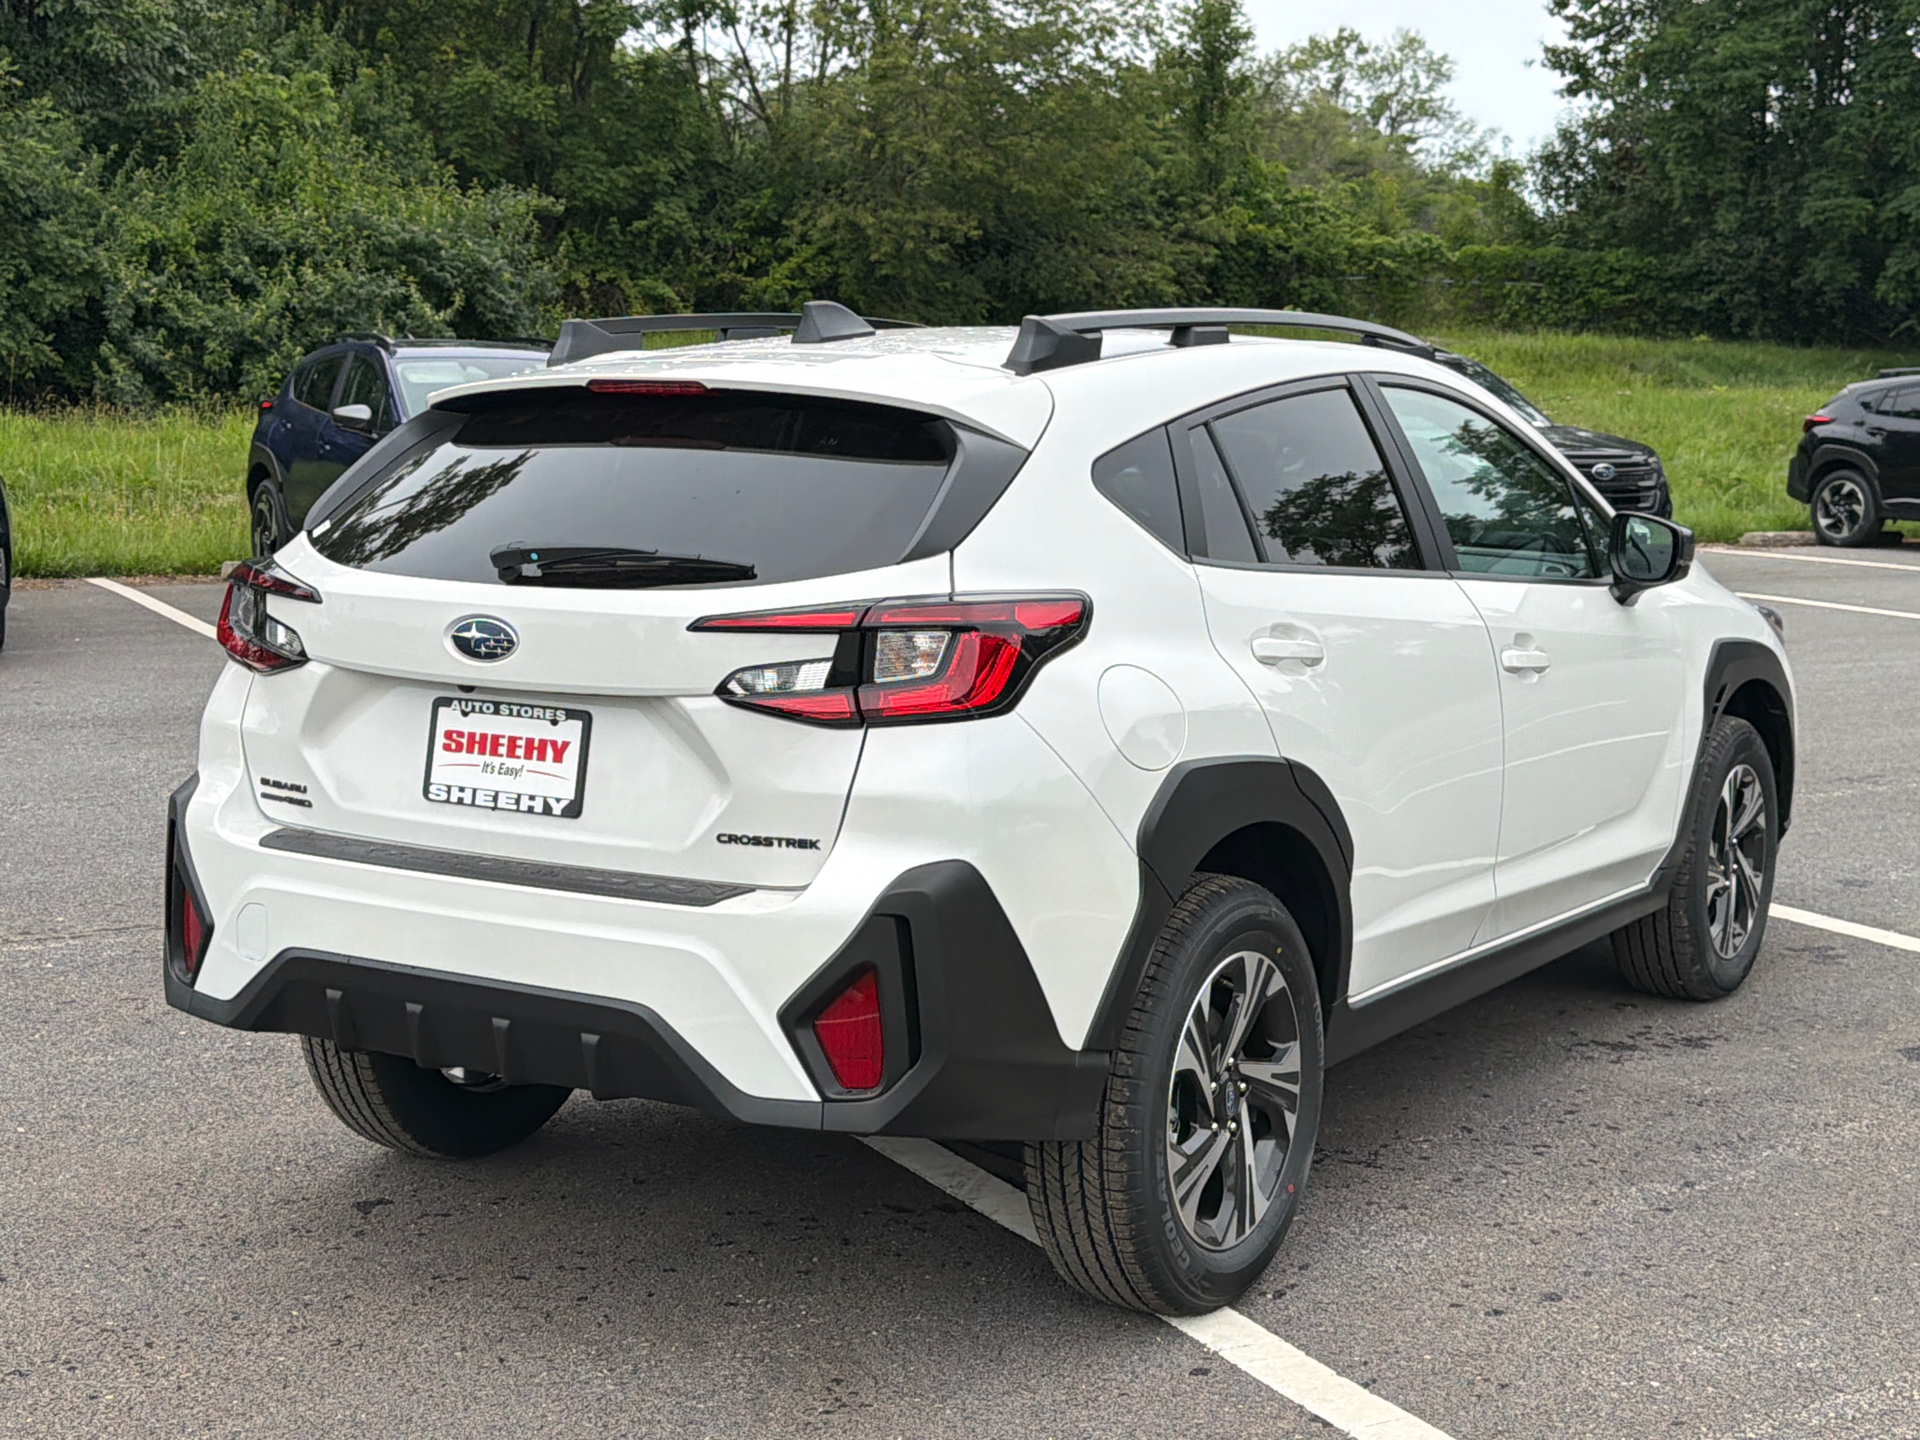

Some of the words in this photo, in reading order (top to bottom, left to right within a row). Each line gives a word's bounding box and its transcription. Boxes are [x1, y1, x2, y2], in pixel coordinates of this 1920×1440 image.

[450, 700, 495, 714] AUTO
[498, 704, 567, 721] STORES
[442, 729, 571, 764] SHEEHY
[481, 760, 496, 775] It's
[497, 762, 525, 780] Easy!
[428, 784, 571, 816] SHEEHY
[716, 832, 822, 851] CROSSTREK
